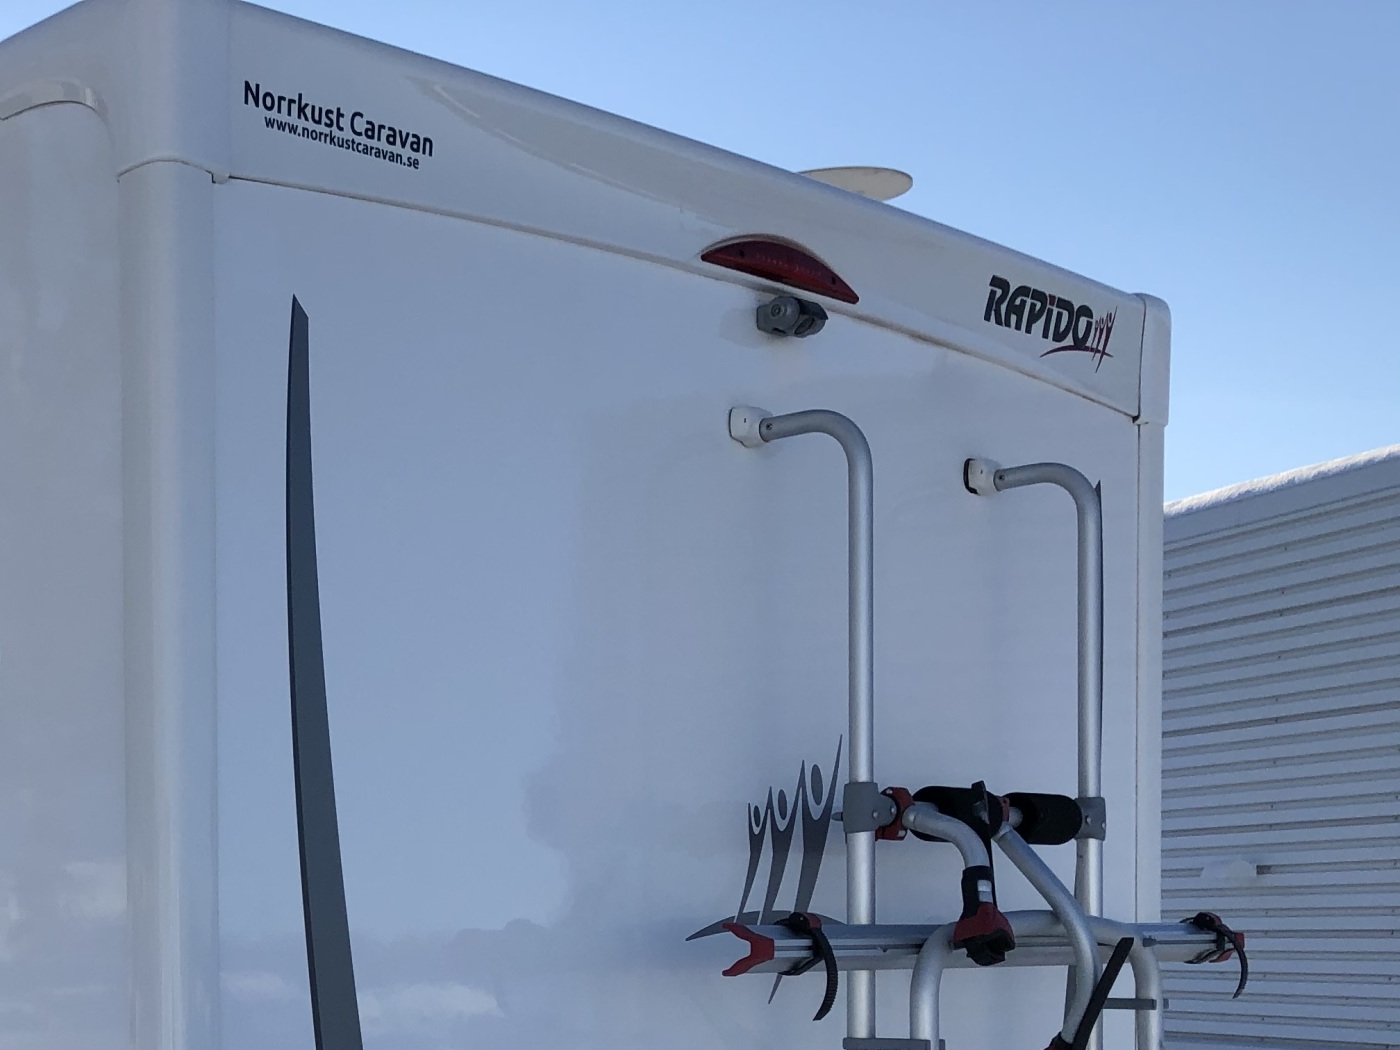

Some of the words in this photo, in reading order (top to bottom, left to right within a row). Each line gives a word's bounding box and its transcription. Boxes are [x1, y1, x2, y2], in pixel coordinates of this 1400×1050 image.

[243, 79, 345, 132] Norrkust
[349, 111, 434, 157] Caravan
[263, 115, 420, 170] www.norrkustcaravan.se
